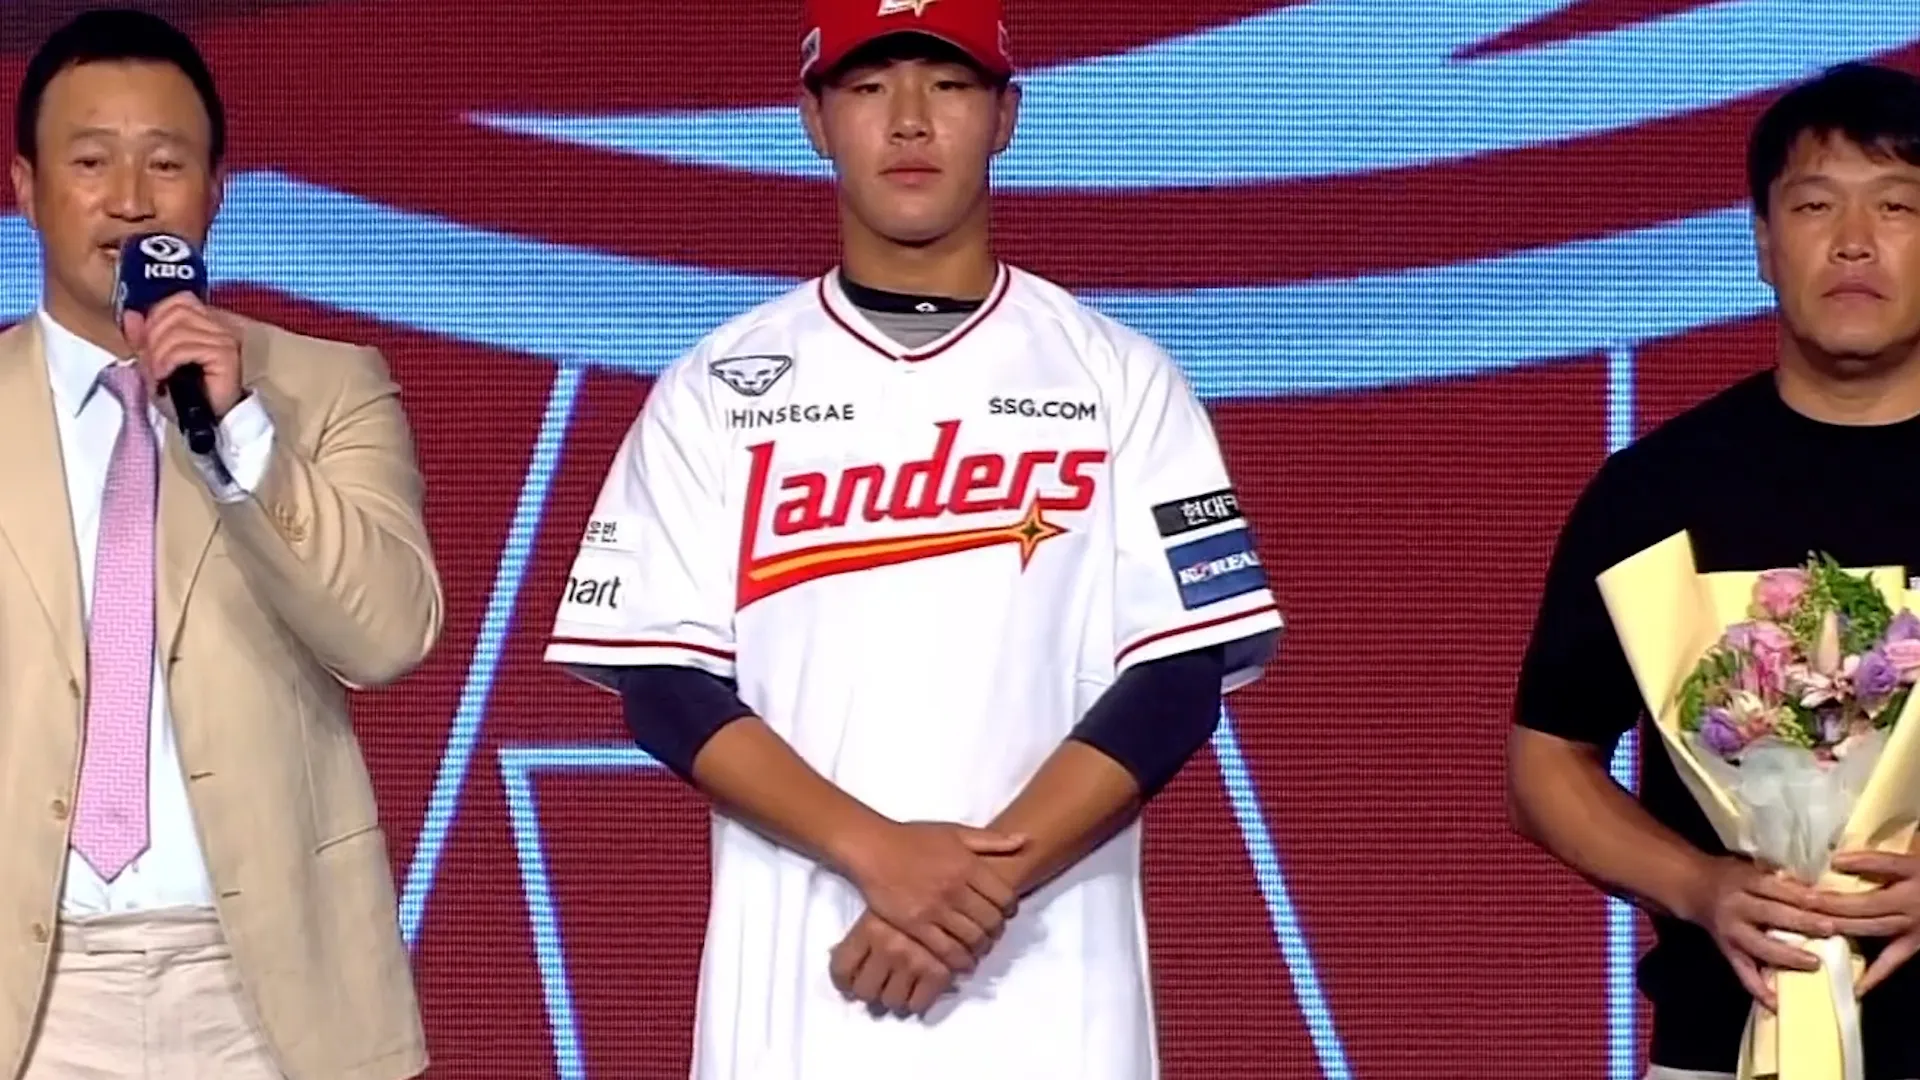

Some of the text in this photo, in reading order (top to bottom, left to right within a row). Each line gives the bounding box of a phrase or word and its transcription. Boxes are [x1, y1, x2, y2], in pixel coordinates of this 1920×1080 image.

[144, 263, 194, 280] KBO
[725, 403, 855, 431] HINSEGAE
[988, 396, 1096, 421] SSG.COM
[735, 420, 1108, 612] Landers
